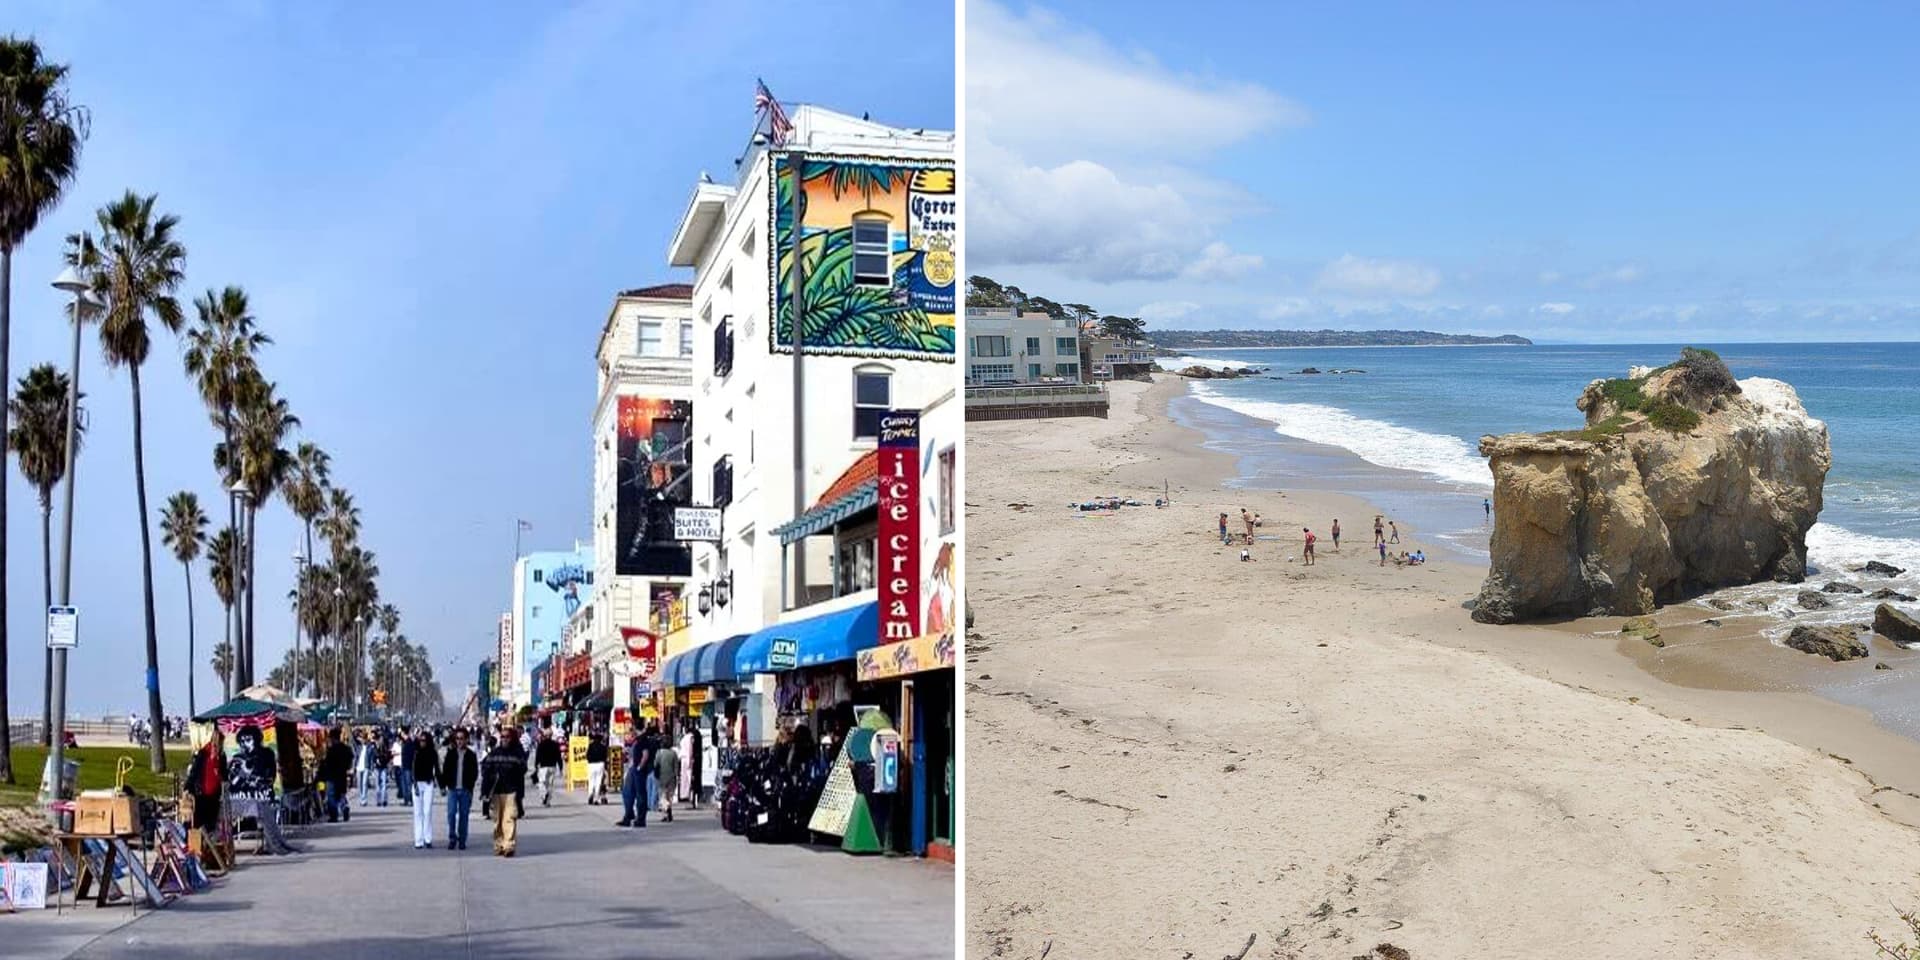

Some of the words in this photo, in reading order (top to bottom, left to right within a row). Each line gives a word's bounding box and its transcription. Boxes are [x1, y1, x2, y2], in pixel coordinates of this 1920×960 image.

[889, 453, 909, 521] ice
[675, 518, 711, 528] SUITES
[687, 528, 721, 538] HOTEL
[885, 534, 913, 638] cream
[773, 640, 796, 654] ATM
